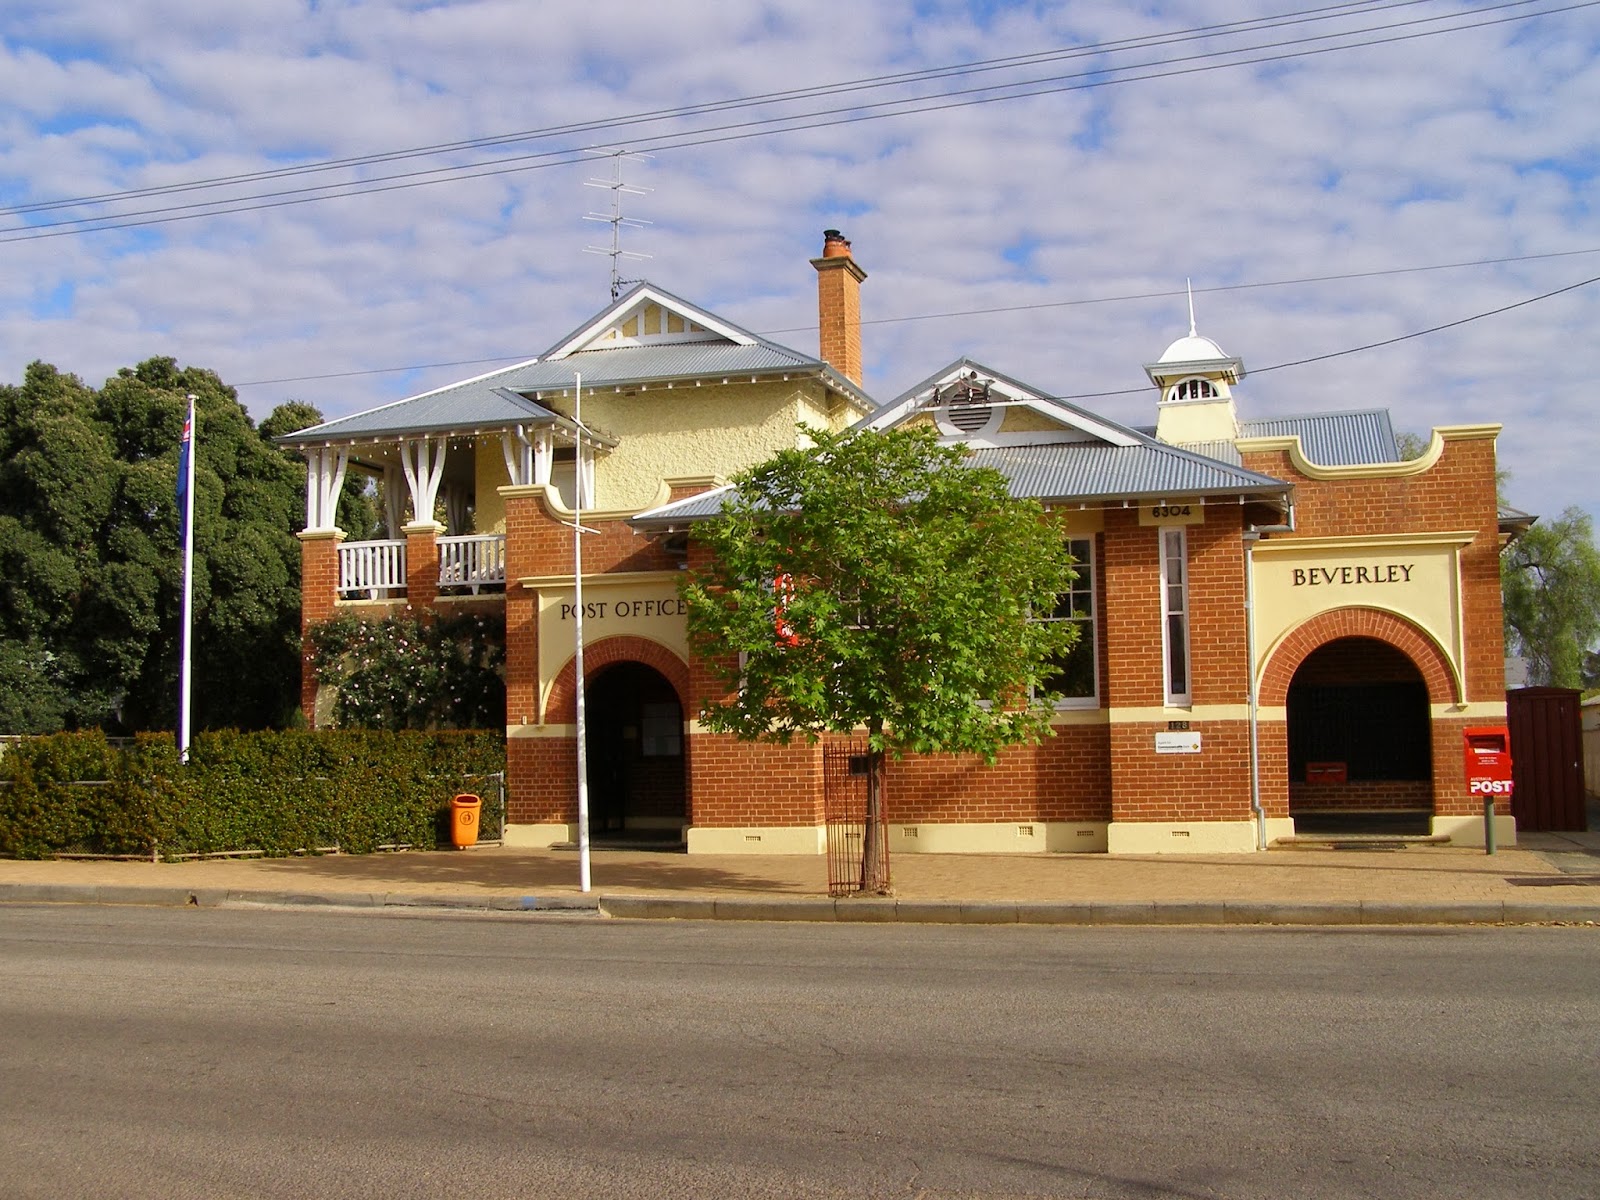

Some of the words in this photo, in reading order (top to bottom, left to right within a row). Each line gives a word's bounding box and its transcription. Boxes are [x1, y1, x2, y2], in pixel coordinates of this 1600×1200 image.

[1292, 564, 1415, 586] BEVERLEY
[615, 599, 687, 617] OFFICE
[1170, 721, 1187, 729] 128
[1470, 780, 1513, 793] POST
